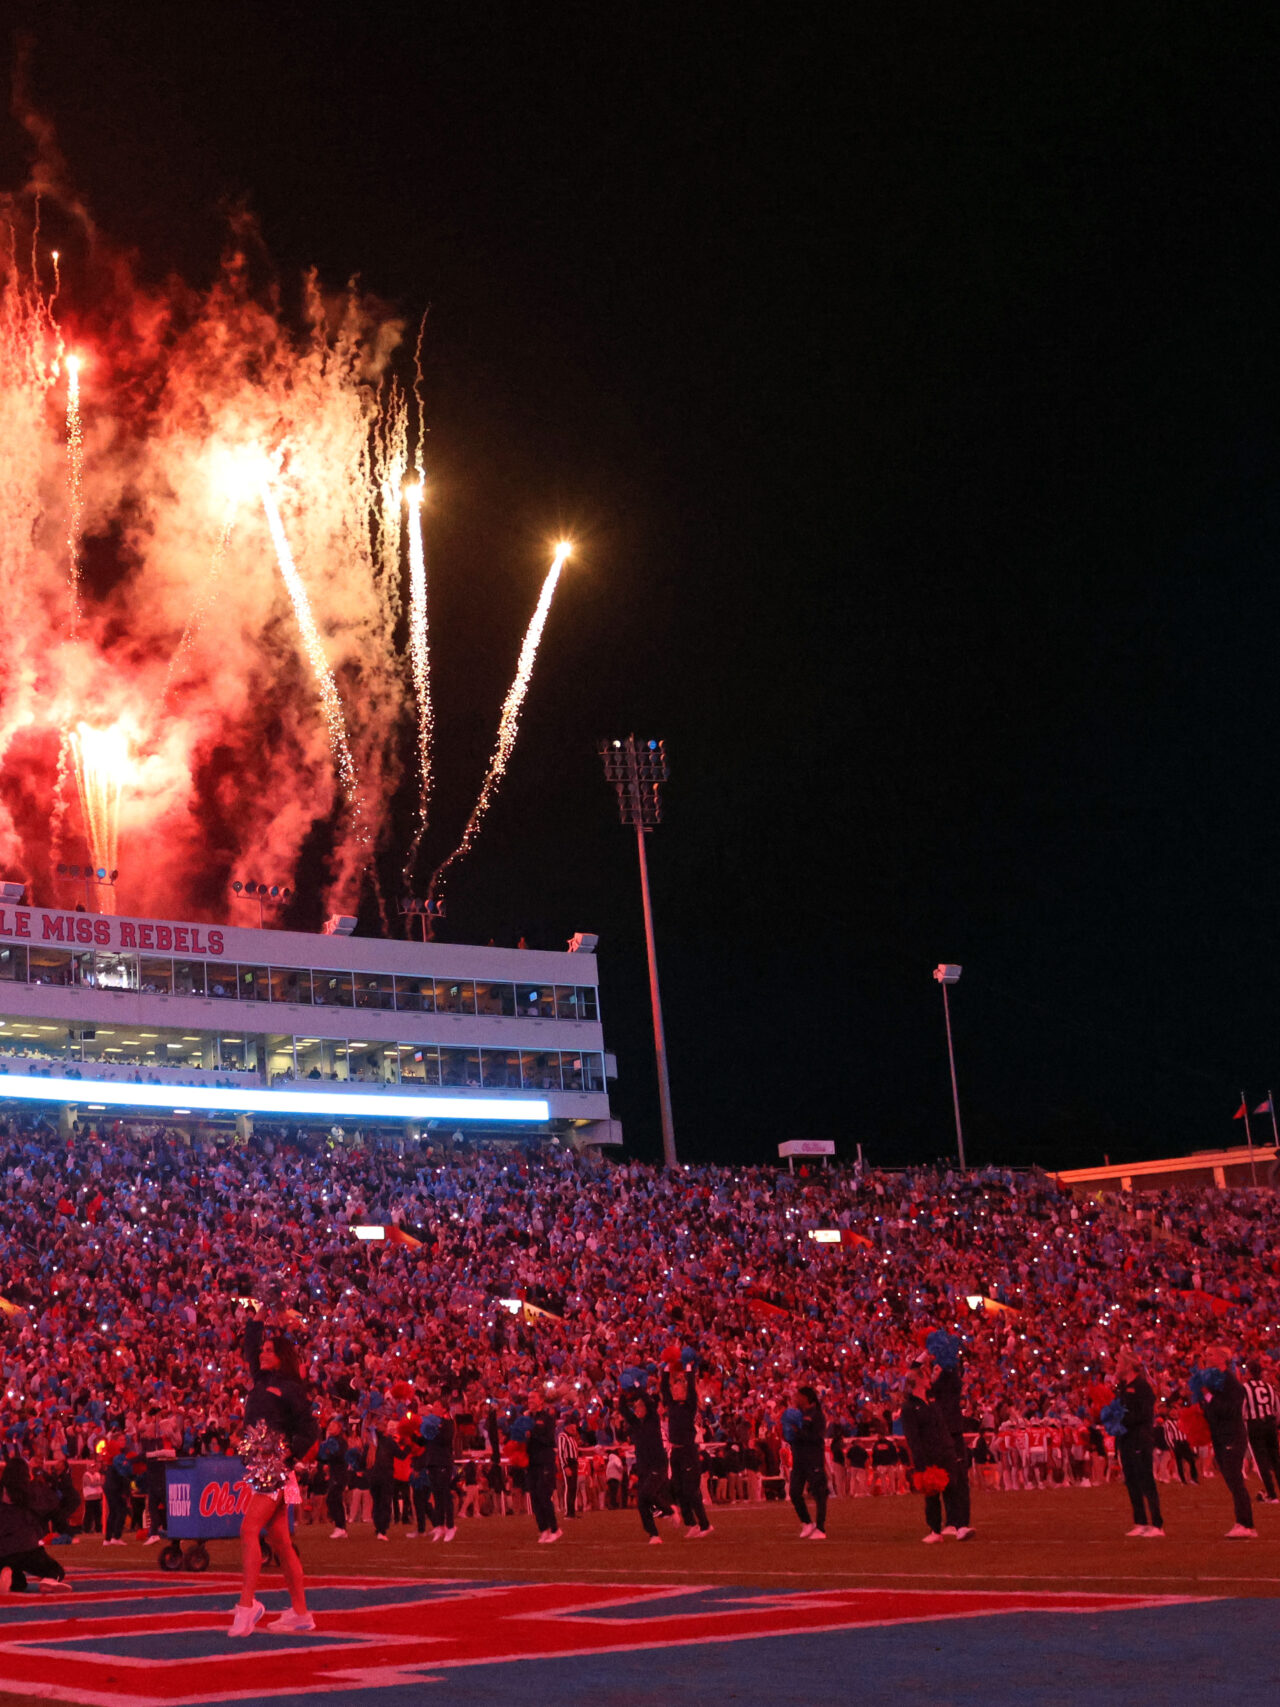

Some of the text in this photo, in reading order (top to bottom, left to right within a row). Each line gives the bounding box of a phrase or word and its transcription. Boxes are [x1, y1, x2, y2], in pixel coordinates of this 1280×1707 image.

[41, 914, 111, 945] MISS
[120, 921, 224, 955] REBELS
[1255, 1386, 1269, 1404] C
[199, 1481, 235, 1517] Ole
